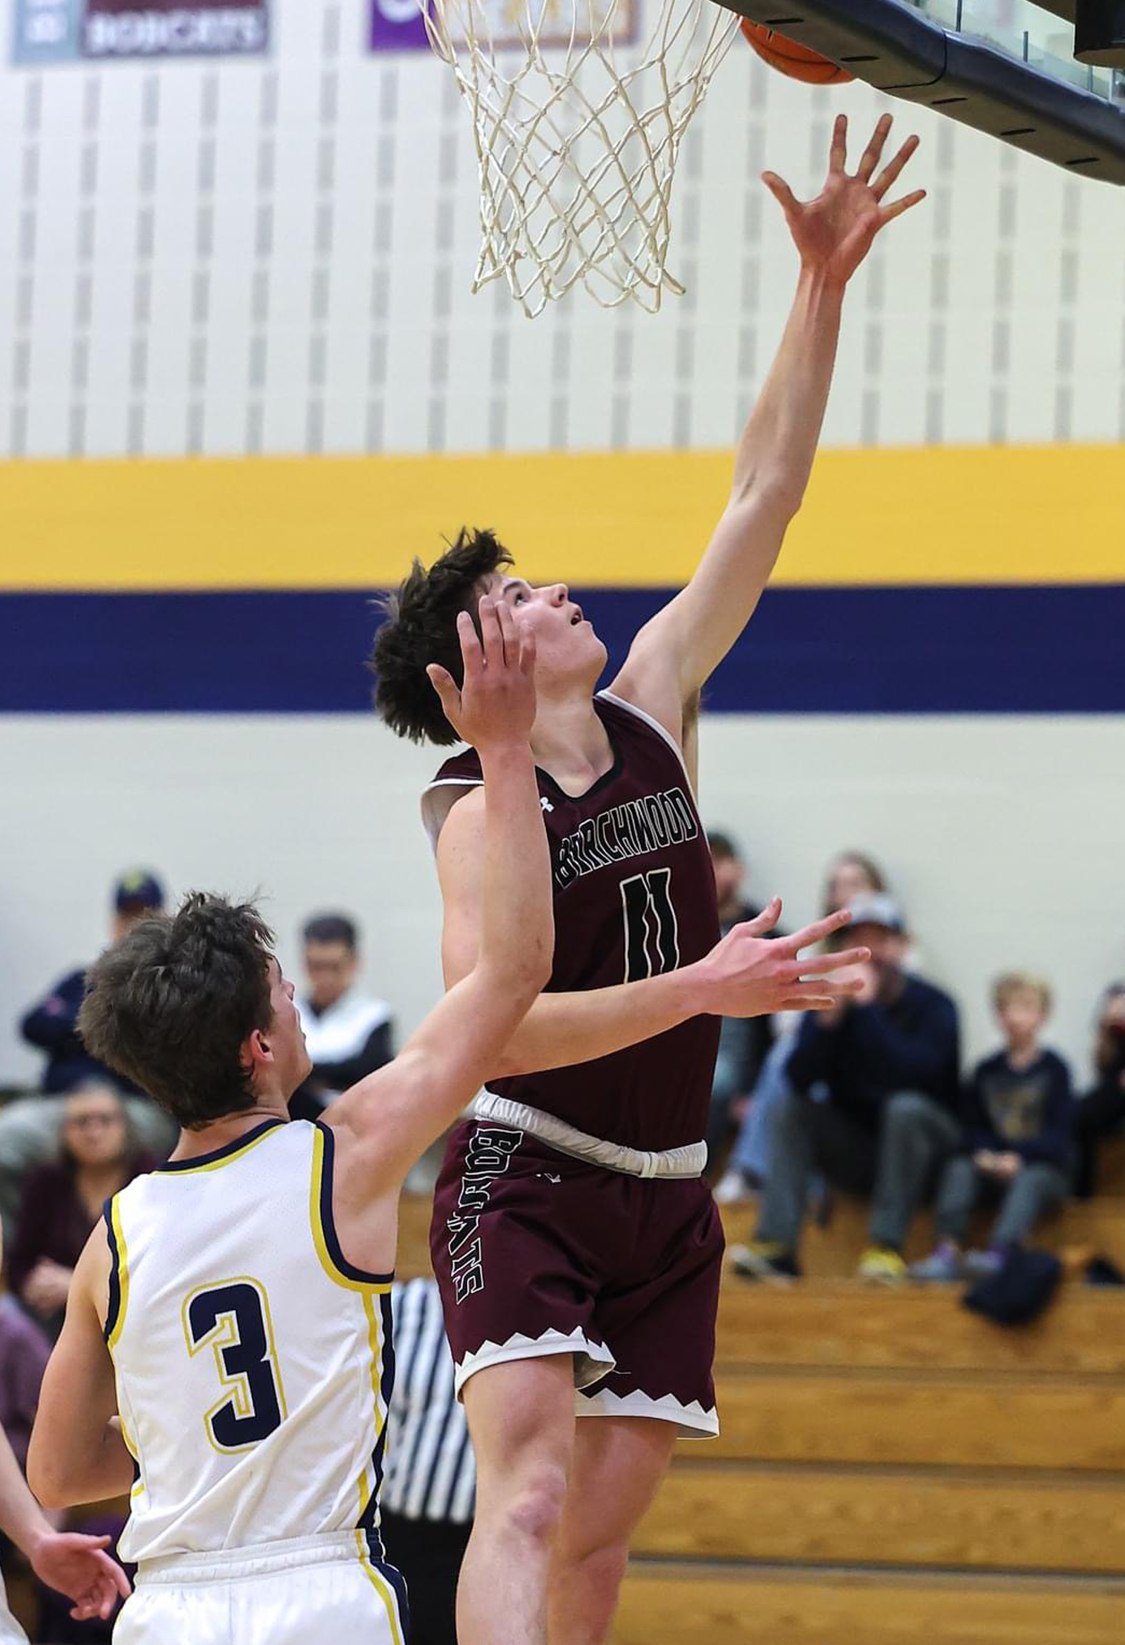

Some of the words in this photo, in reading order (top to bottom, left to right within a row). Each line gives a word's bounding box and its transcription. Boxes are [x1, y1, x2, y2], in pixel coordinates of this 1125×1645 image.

[555, 787, 698, 889] BIRCHWOOD
[619, 867, 680, 984] 11
[447, 1128, 523, 1305] BOBATS
[181, 1276, 288, 1455] 3
